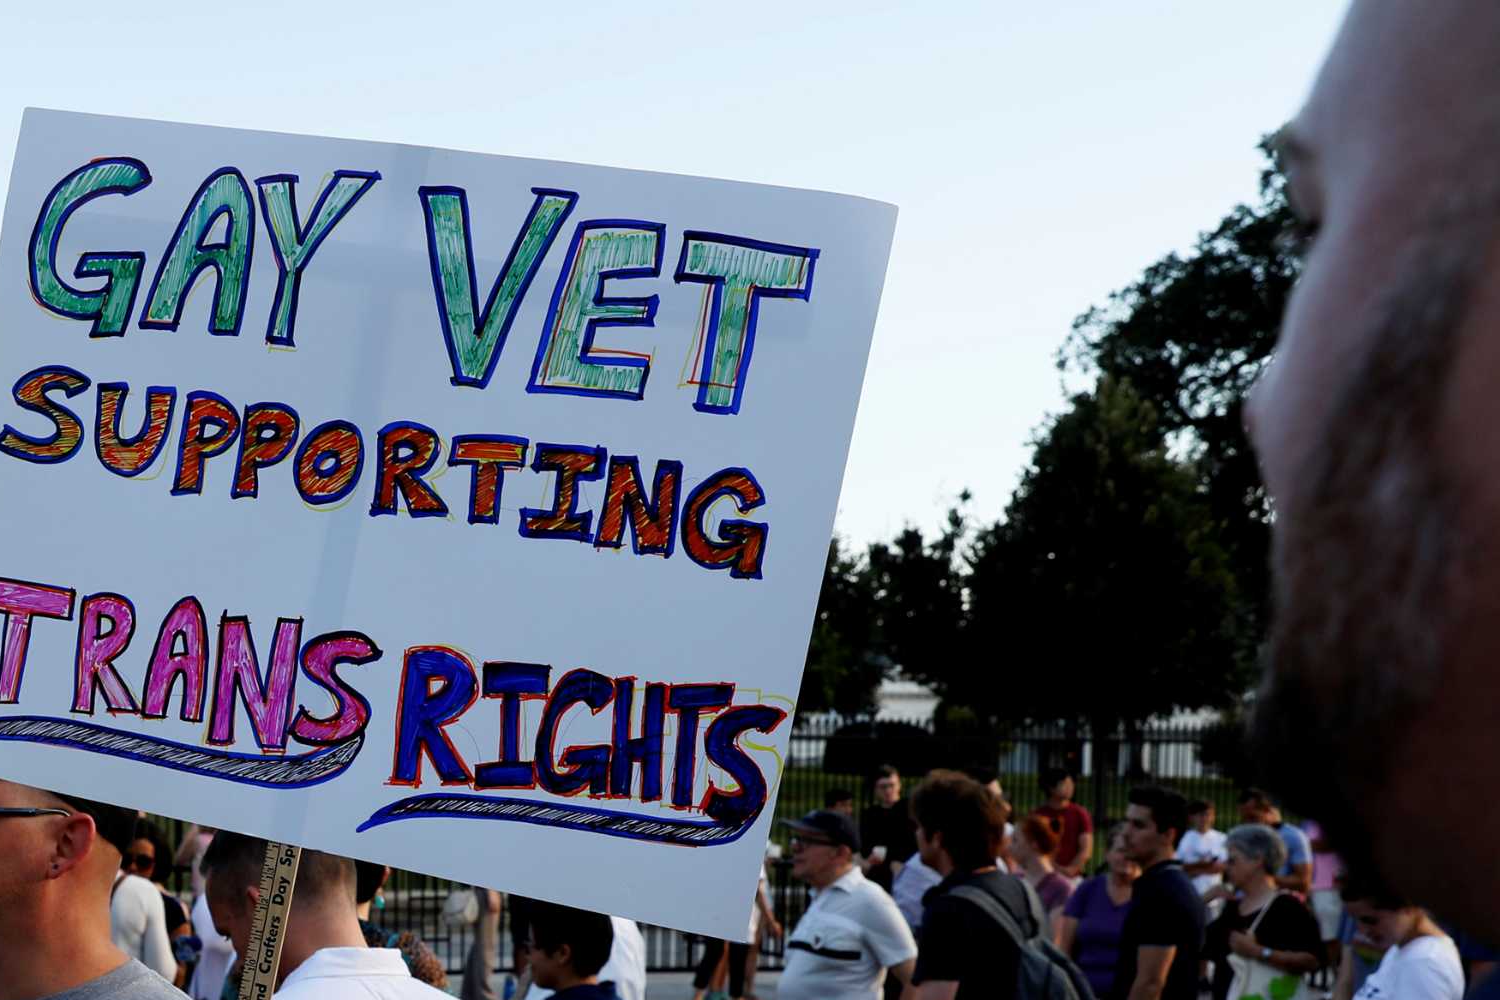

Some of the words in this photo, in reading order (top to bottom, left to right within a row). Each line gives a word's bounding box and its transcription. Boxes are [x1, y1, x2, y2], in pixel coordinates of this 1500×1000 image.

[25, 154, 383, 348] GAY
[418, 184, 821, 414] VET
[385, 645, 789, 822] RIGHTS
[259, 916, 281, 975] Crafters
[272, 876, 291, 906] Day
